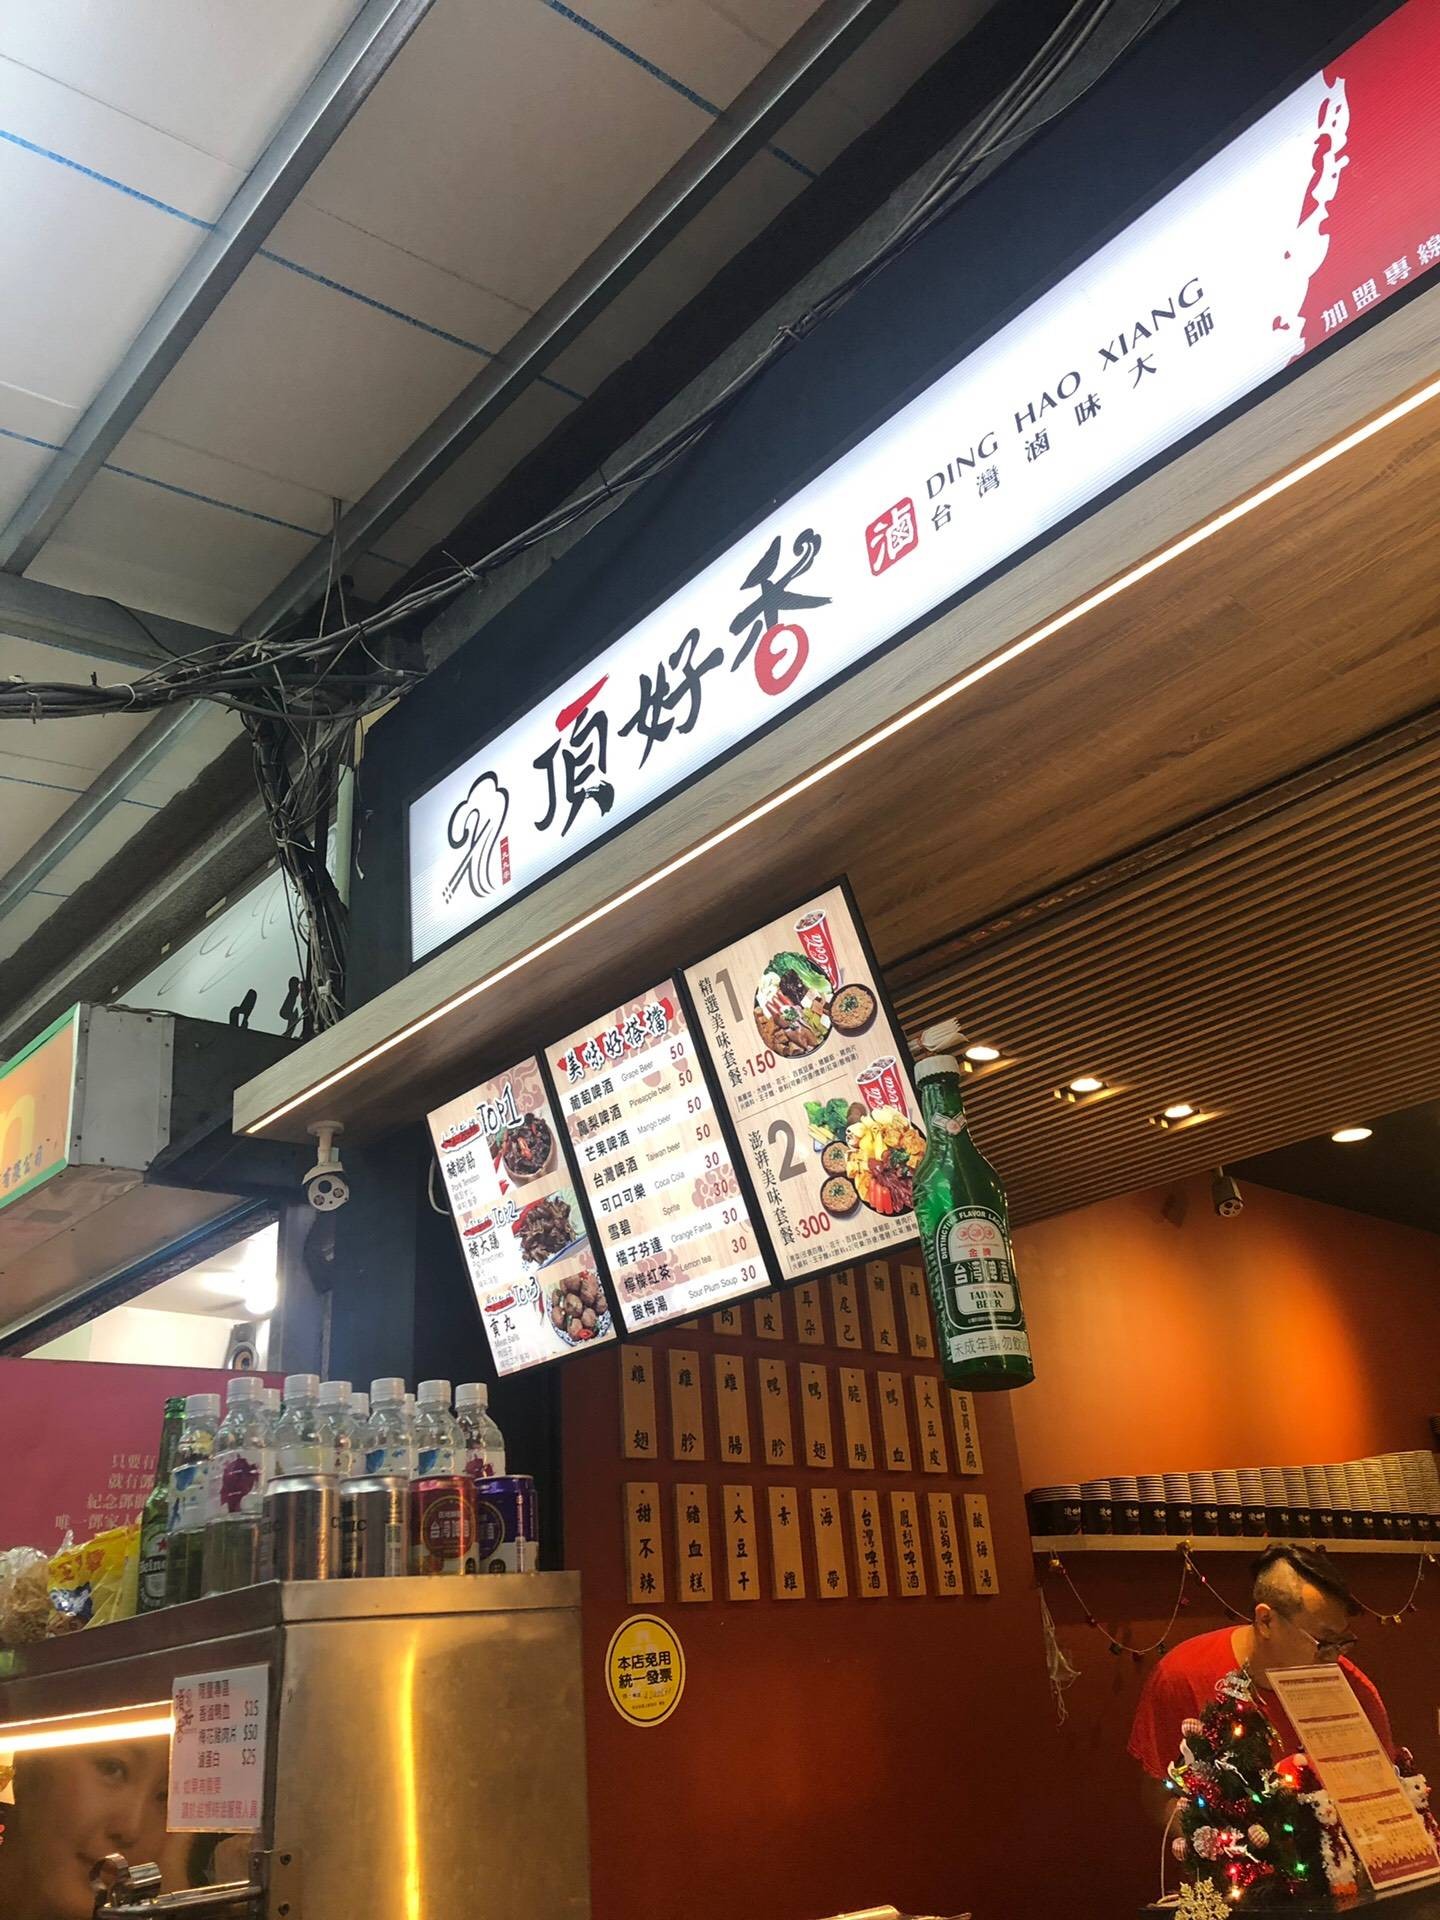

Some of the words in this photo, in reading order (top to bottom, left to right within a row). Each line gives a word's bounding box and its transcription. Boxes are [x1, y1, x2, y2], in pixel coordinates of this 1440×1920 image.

[925, 431, 999, 500] DING
[1013, 371, 1081, 433] HAO
[1097, 277, 1204, 371] XIANG
[930, 307, 1214, 531] 台灣滷味大師
[868, 499, 916, 574] 滷
[533, 528, 833, 836] 頂好香
[714, 967, 743, 1023] 1
[670, 1042, 684, 1060] 50
[698, 977, 743, 1087] 精選美味套餐
[679, 1069, 693, 1087] 50
[742, 1050, 776, 1077] $150
[477, 1085, 523, 1134] TOP1
[687, 1096, 702, 1114] 50
[696, 1124, 710, 1141] 50
[704, 1151, 719, 1169] 30
[767, 1119, 808, 1182] 2
[713, 1180, 728, 1197] 30
[722, 1207, 738, 1225] 30
[748, 1130, 795, 1246] 澎湃美味套餐
[958, 1209, 986, 1220] FLAVOR
[731, 1236, 747, 1253] 30
[795, 1211, 830, 1239] $300
[741, 1264, 756, 1282] 30
[489, 1314, 516, 1338] 貢丸
[976, 1299, 1002, 1309] BEER
[631, 1365, 649, 1450] 雞翅
[923, 1396, 942, 1466] 大豆皮
[635, 1503, 656, 1594] 甜不辣
[685, 1505, 706, 1593] 豬血糕
[732, 1505, 750, 1592] 大豆干
[777, 1506, 798, 1591] 素雞
[819, 1507, 840, 1590] 海帶
[861, 1508, 881, 1589] 台灣啤酒
[900, 1509, 920, 1588] 鳳梨啤酒
[937, 1510, 956, 1588] 葡萄啤酒
[972, 1512, 992, 1588] 酸梅湯
[617, 1651, 671, 1671] 本店免用
[618, 1668, 672, 1689] 統一發票
